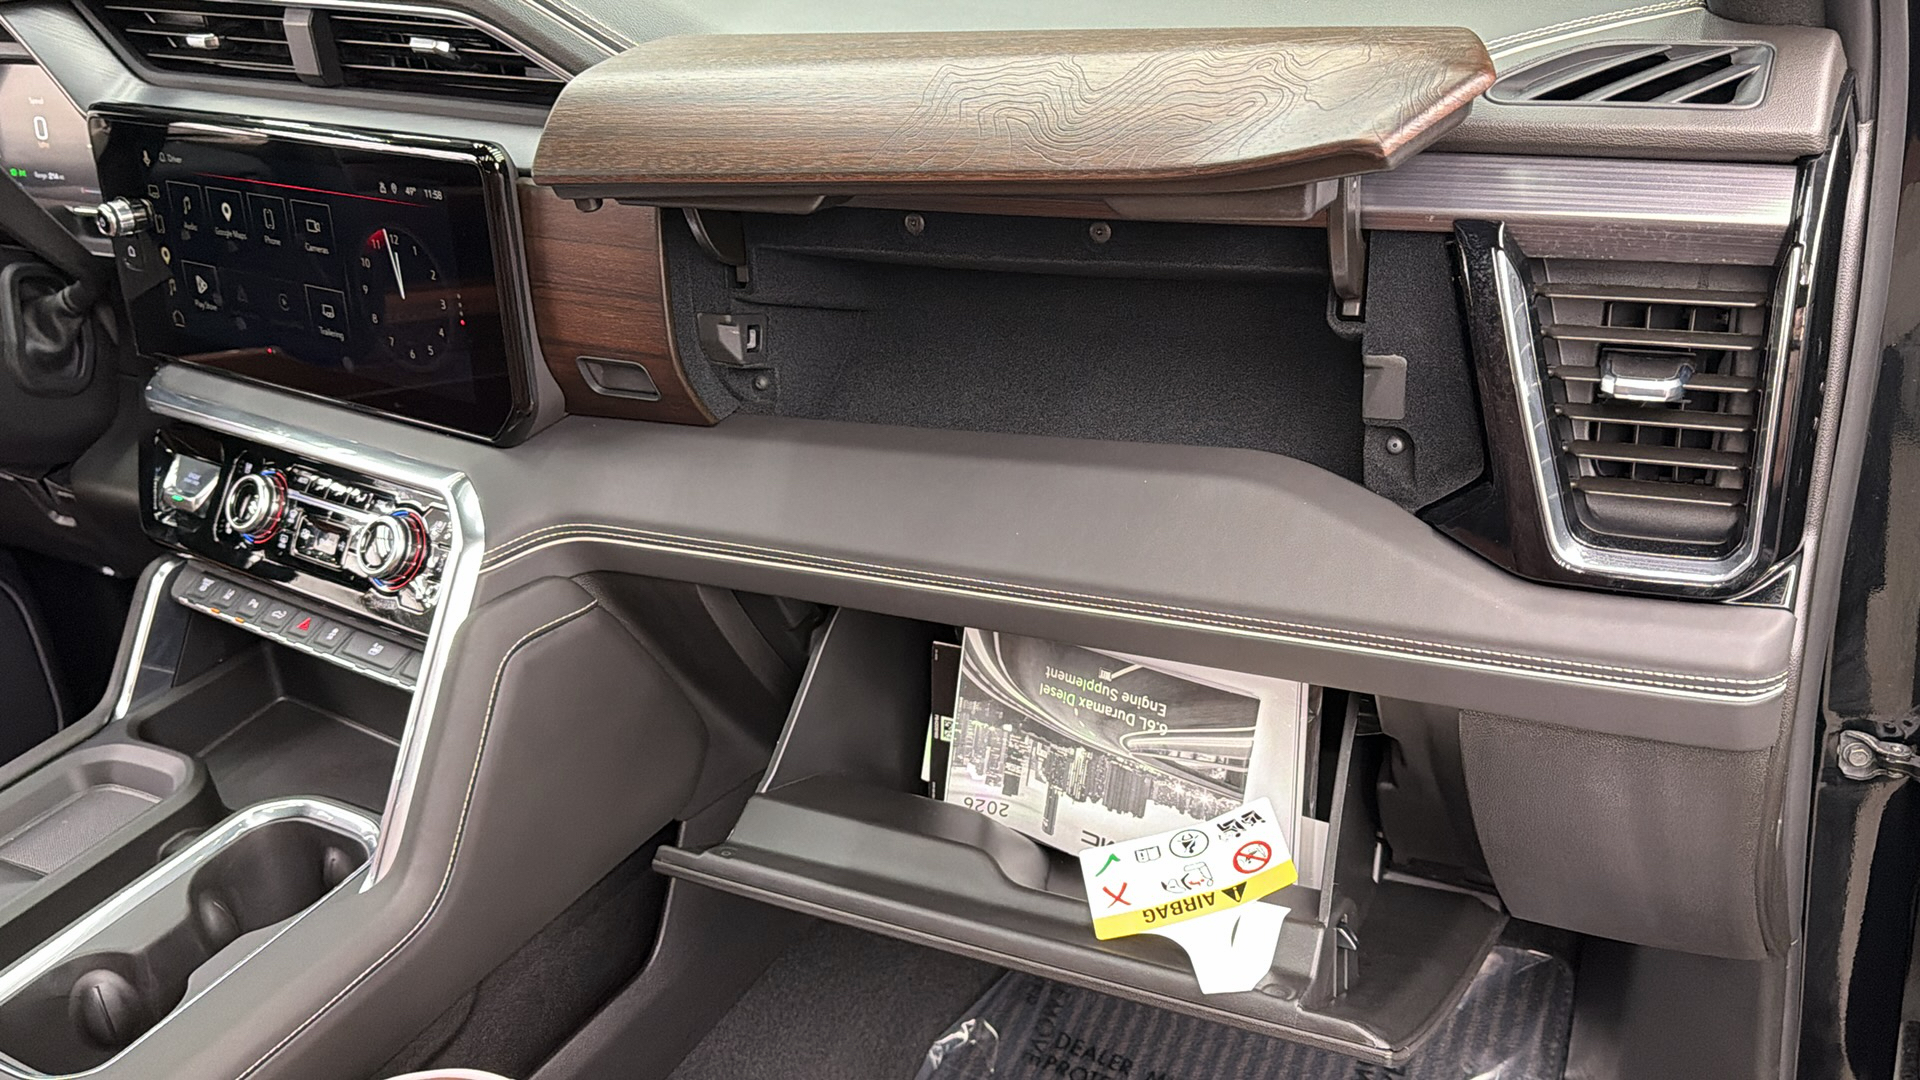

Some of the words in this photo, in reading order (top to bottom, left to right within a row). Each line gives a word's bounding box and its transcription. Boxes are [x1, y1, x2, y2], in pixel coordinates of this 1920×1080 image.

[33, 115, 49, 141] 0
[423, 188, 443, 201] 11:58
[371, 239, 381, 249] 11
[389, 234, 399, 245] 12
[412, 246, 418, 256] 1
[360, 257, 371, 269] 10
[430, 270, 437, 281] 2
[362, 285, 369, 295] 9
[440, 299, 447, 310] 3
[371, 313, 378, 324] 8
[438, 327, 445, 337] 4
[388, 336, 395, 347] 7
[409, 349, 416, 359] 6
[427, 345, 434, 356] 5
[1045, 665, 1119, 702] Supplement
[1039, 683, 1076, 707] Diesel
[1121, 691, 1167, 718] Engine
[1078, 696, 1136, 727] Duramax
[1139, 716, 1168, 736] 6.6L
[963, 796, 1010, 817] 2026
[1142, 891, 1216, 923] AIRBAG
[1054, 1031, 1134, 1076] DEALER
